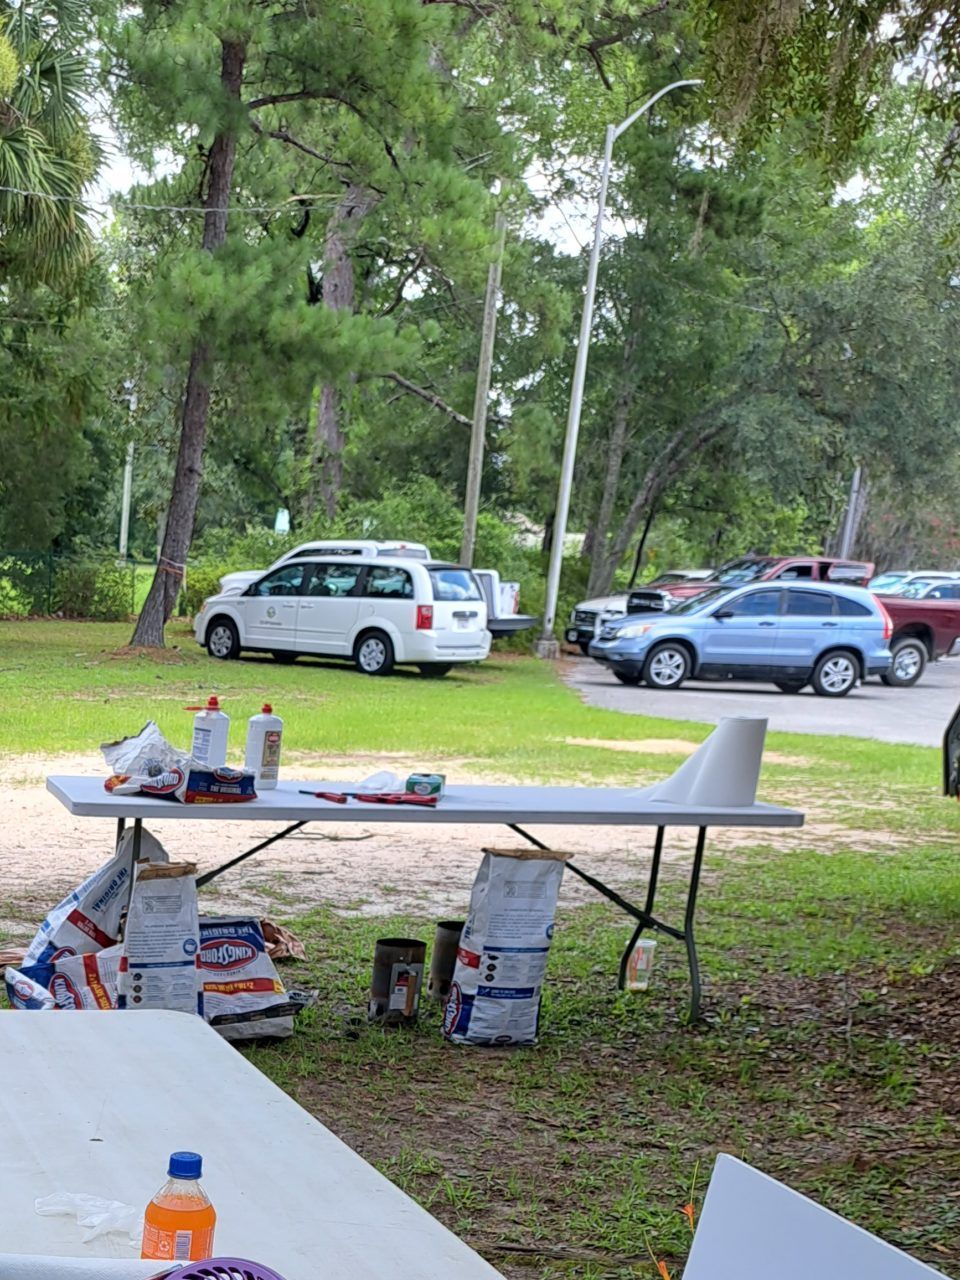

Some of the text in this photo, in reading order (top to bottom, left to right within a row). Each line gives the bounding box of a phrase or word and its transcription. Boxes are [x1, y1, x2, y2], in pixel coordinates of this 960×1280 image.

[92, 878, 119, 913] ORIGINAL
[201, 927, 236, 937] ORIGIN
[200, 944, 253, 966] KINGSFORD
